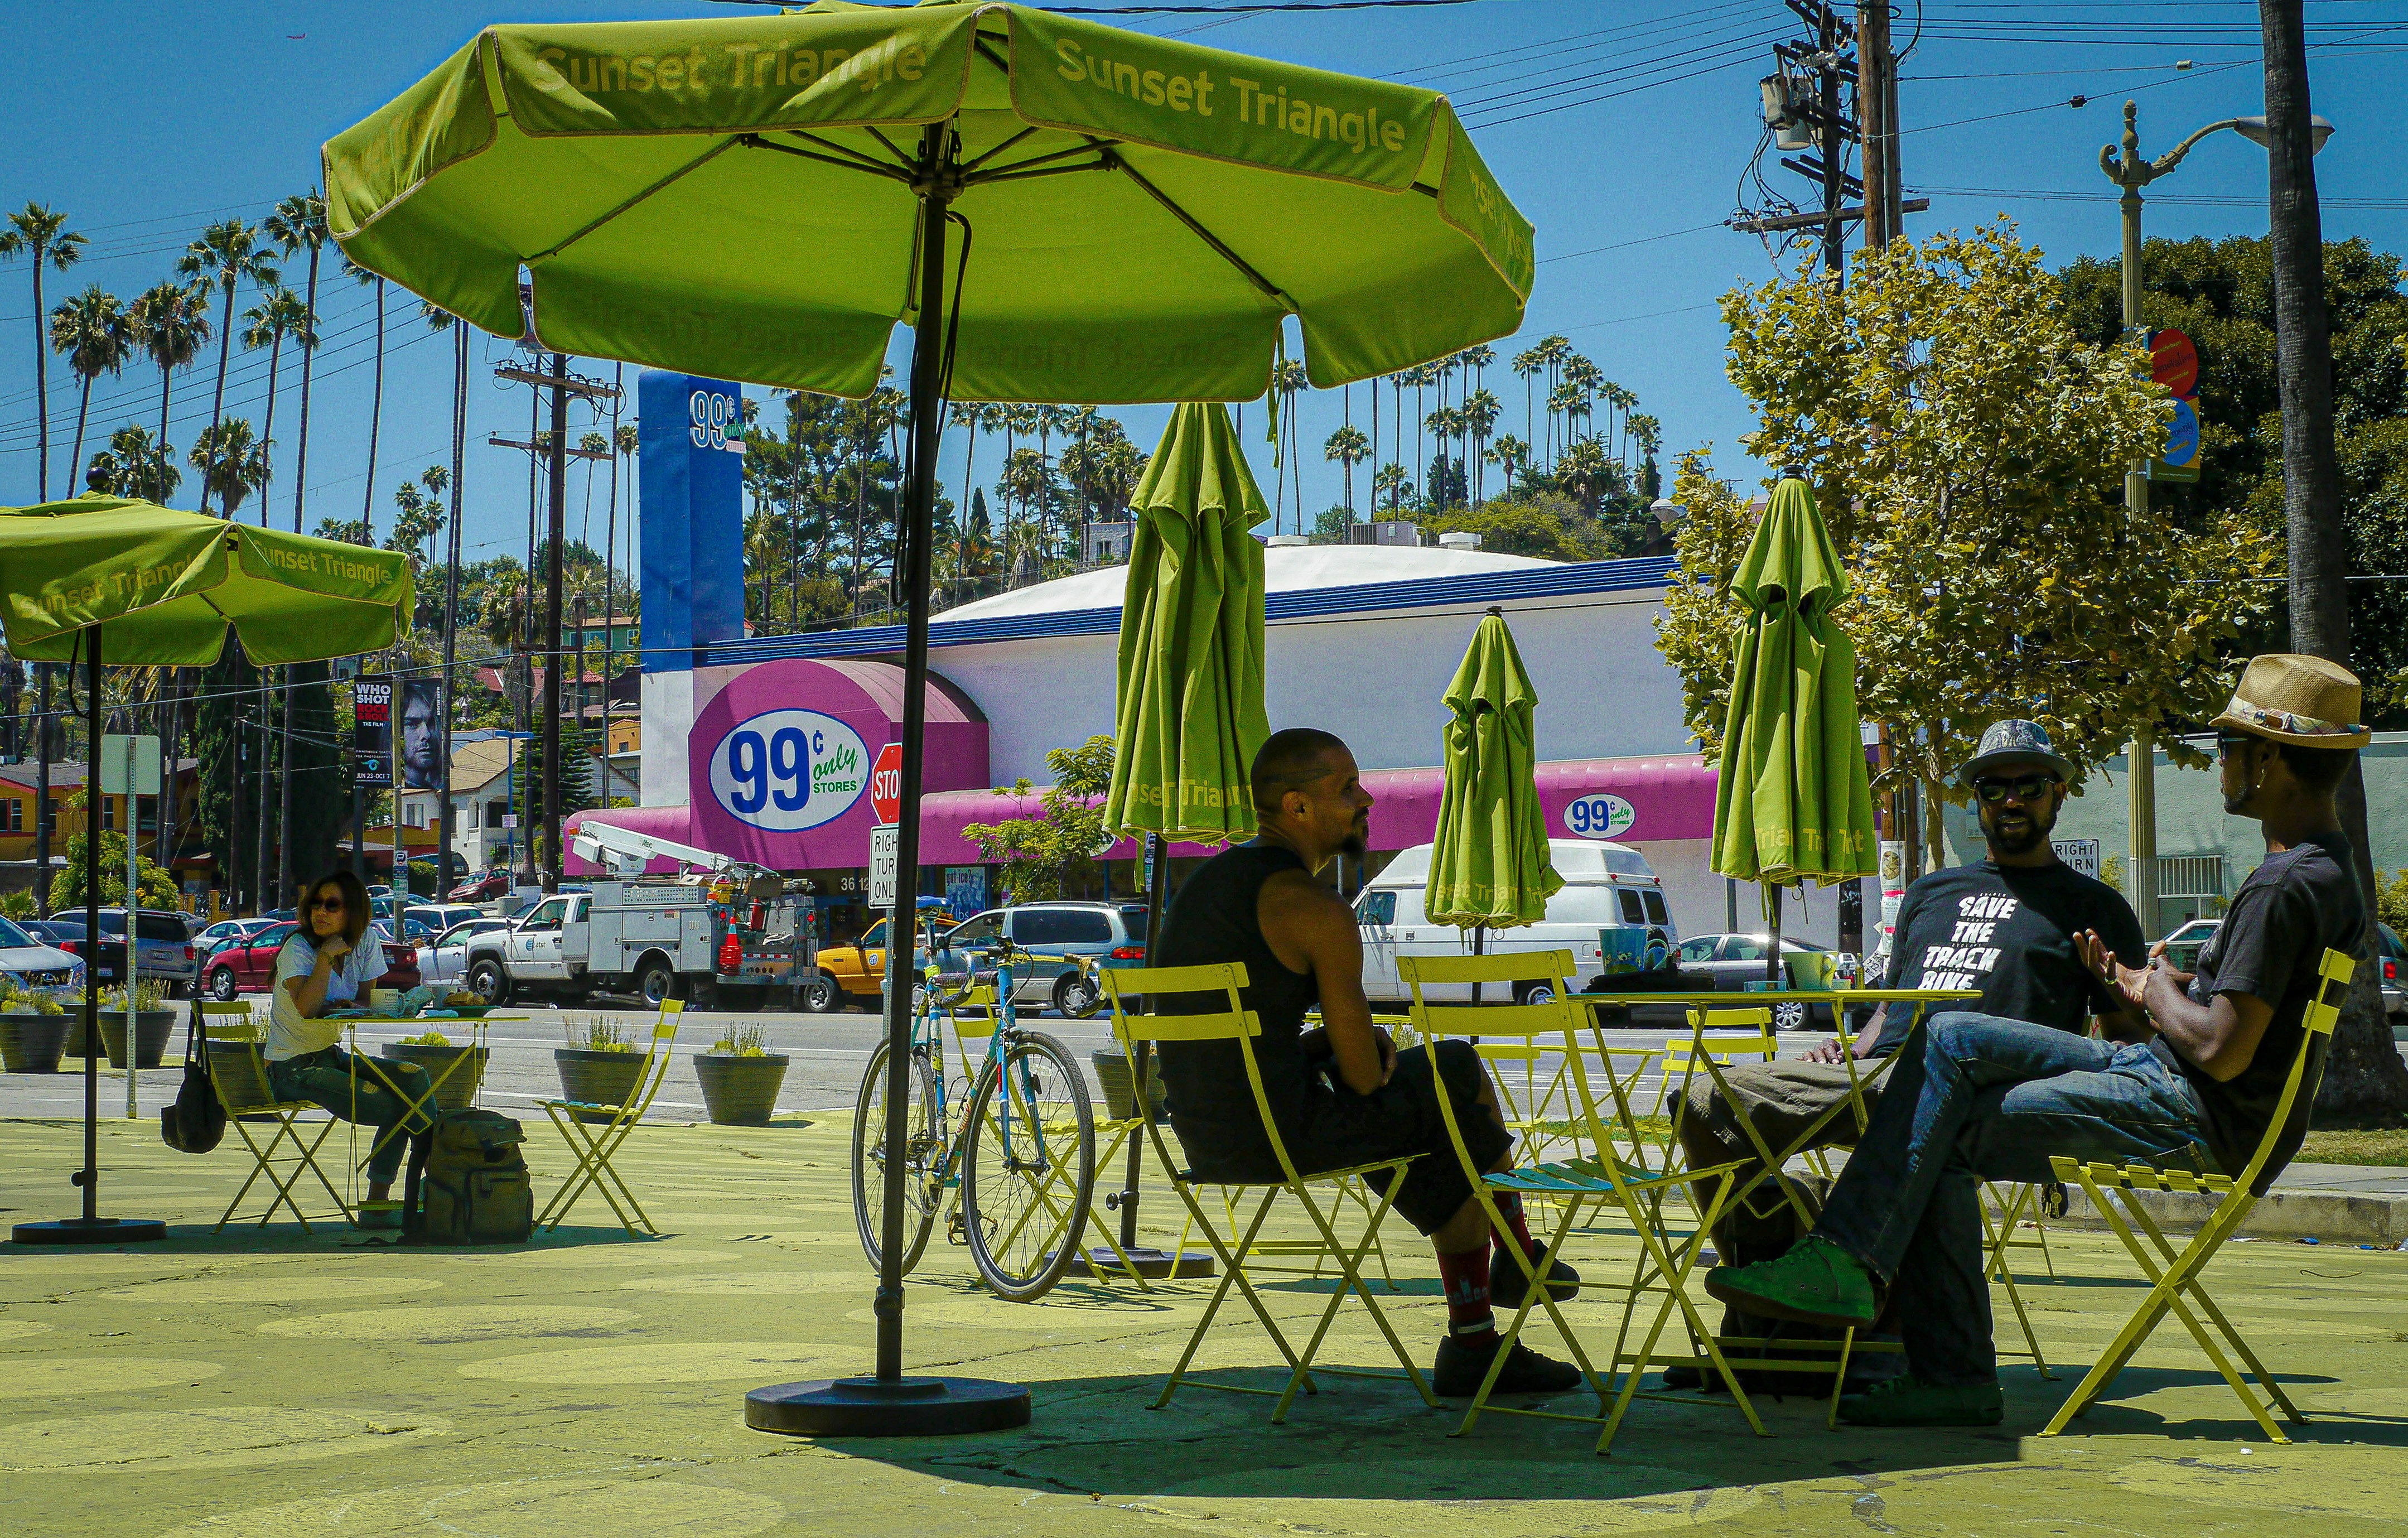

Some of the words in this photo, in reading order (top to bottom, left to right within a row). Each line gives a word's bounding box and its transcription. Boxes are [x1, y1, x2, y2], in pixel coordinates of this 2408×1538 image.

[534, 46, 706, 95] Sunset
[726, 38, 928, 91] Triangle
[1055, 38, 1214, 117] Sunset
[1229, 76, 1406, 153] Triangle
[727, 440, 746, 451] STORES
[320, 553, 394, 589] Triangle
[356, 684, 391, 695] WHO
[356, 694, 389, 705] SHOT
[357, 703, 389, 713] ROCK
[813, 743, 858, 781] only
[813, 780, 857, 794] STORES
[874, 768, 901, 801] STO
[1610, 806, 1630, 821] only
[874, 833, 898, 852] RIGH
[2055, 843, 2095, 856] RIGHT
[876, 857, 897, 876] TUR
[946, 870, 957, 886] got
[958, 869, 972, 885] ice?
[874, 880, 897, 899] ONL
[1958, 896, 2019, 920] SAVE
[1951, 921, 1997, 943] THE
[1923, 946, 2002, 973] TRACK
[1917, 971, 1976, 991] BIKE
